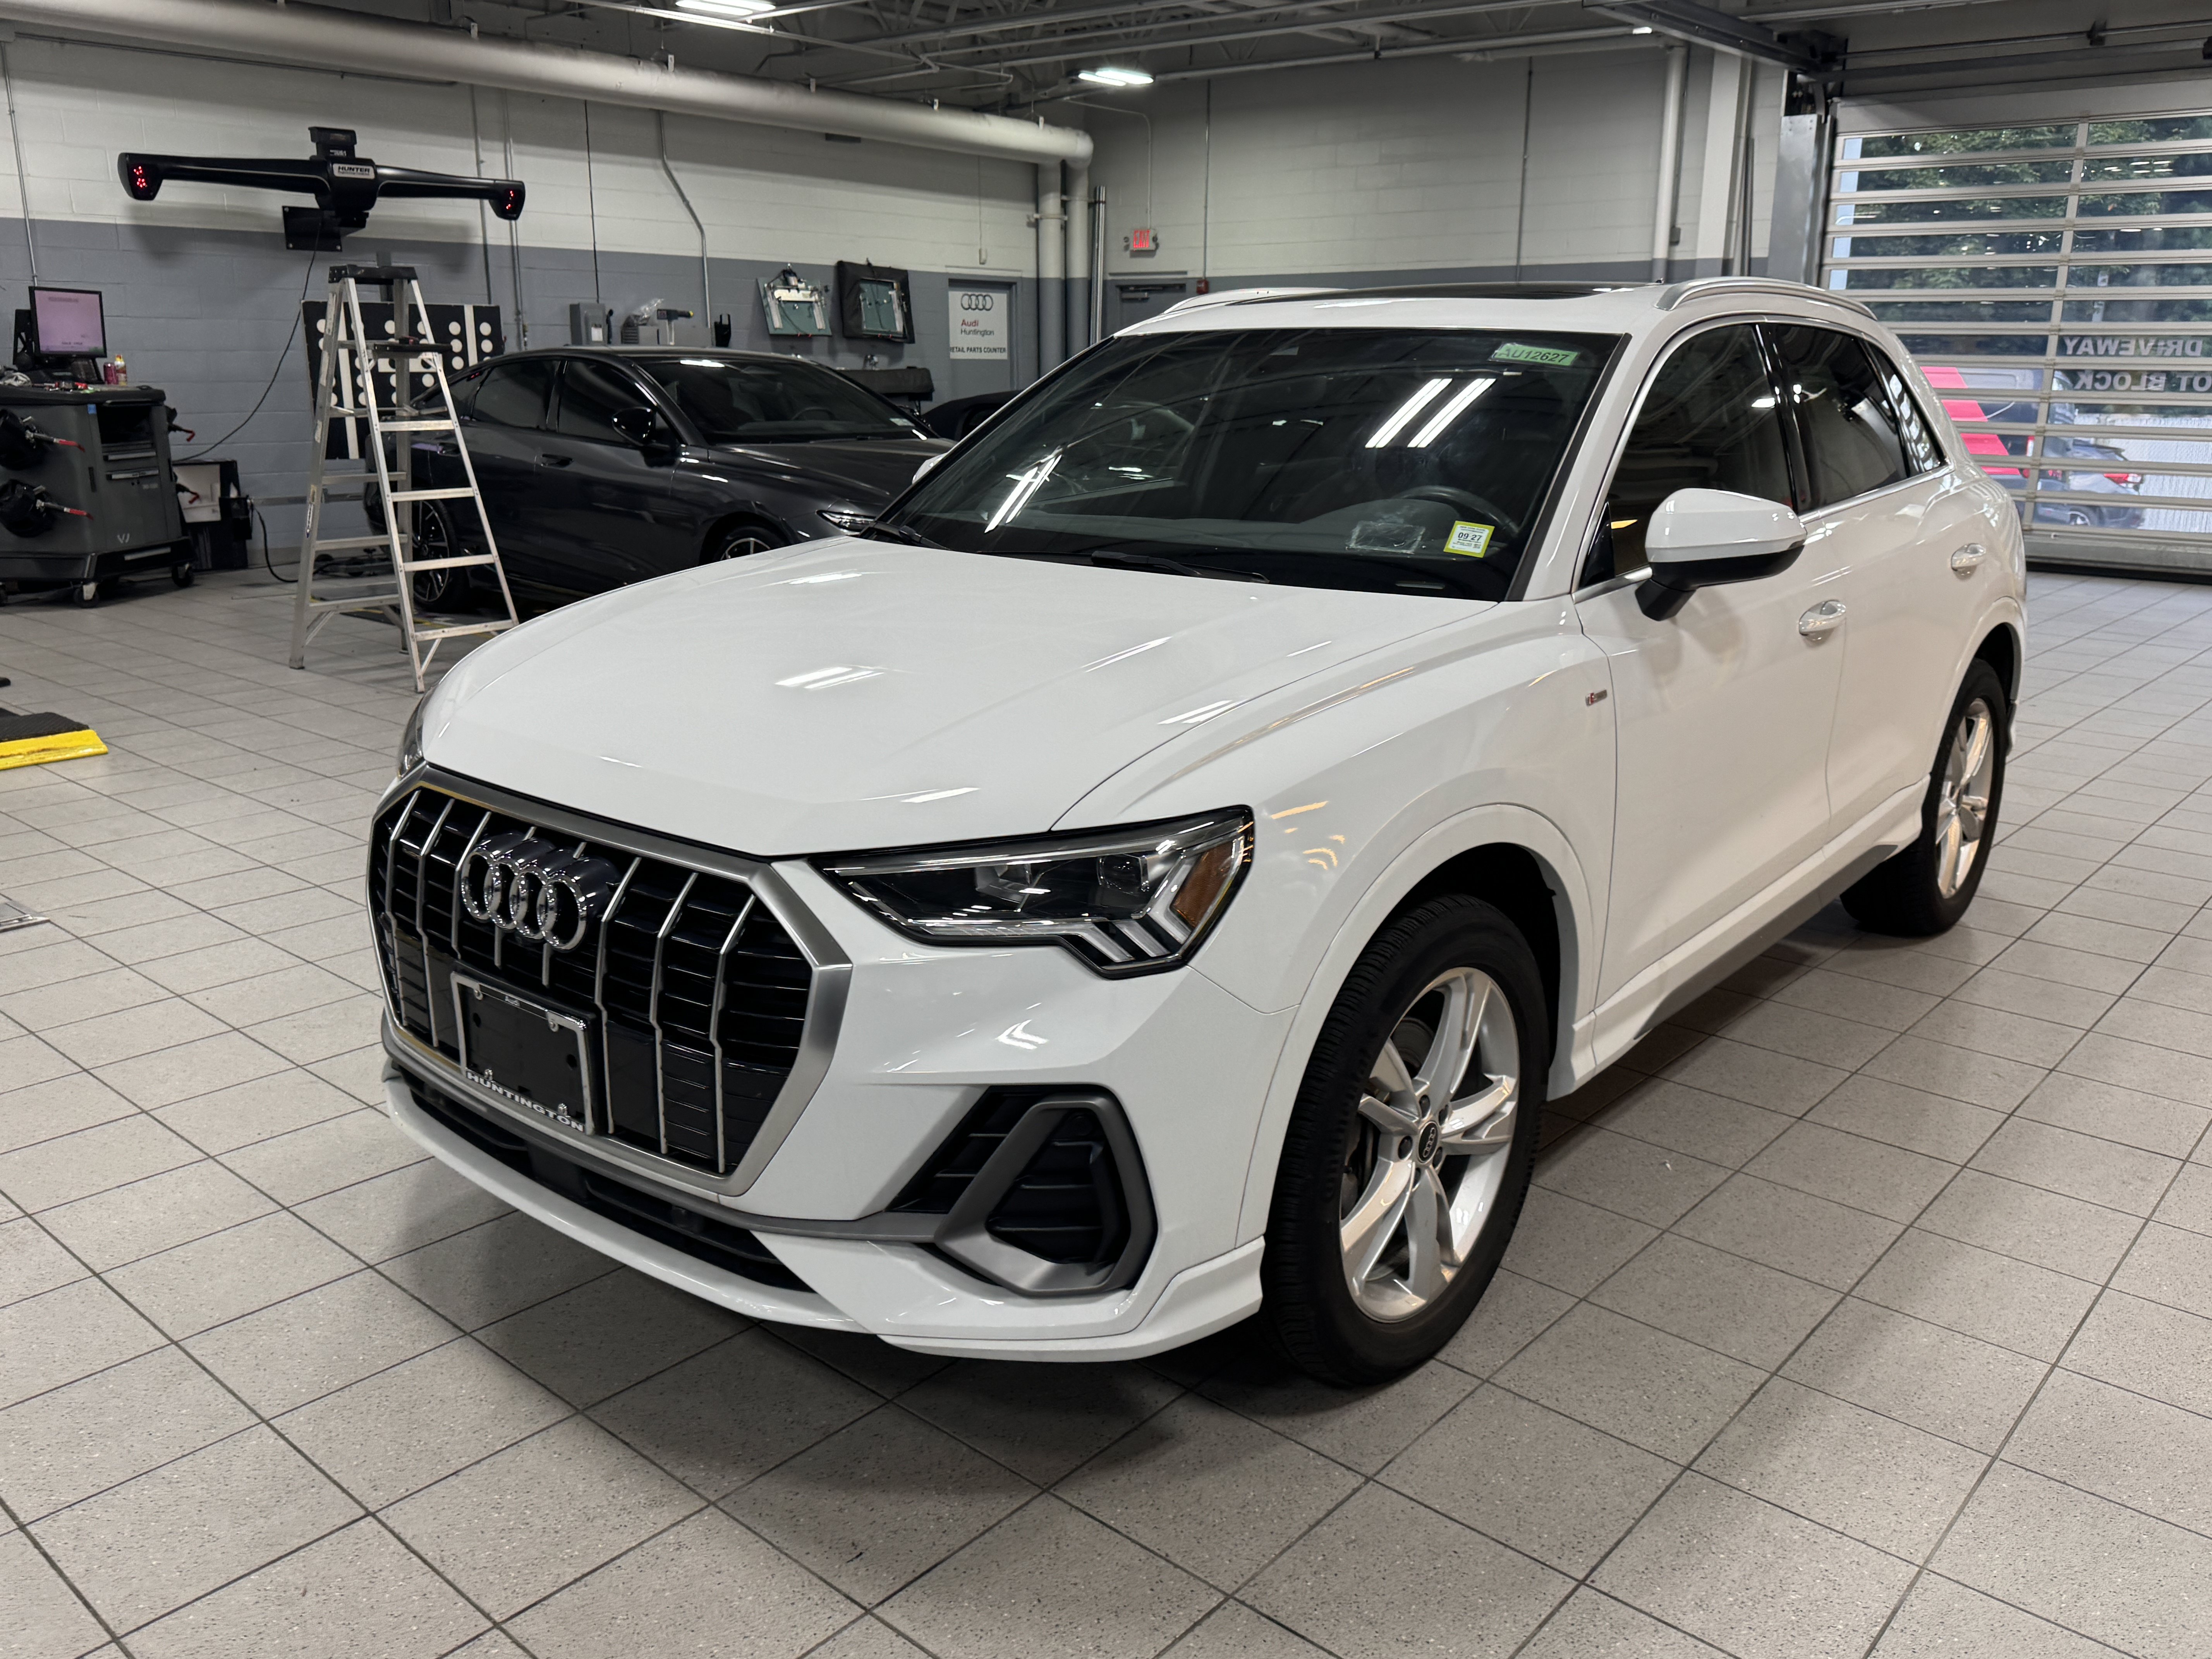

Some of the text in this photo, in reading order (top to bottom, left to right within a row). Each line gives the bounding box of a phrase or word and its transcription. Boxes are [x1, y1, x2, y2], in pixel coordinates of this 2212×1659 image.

[1133, 229, 1150, 248] EXIT
[1498, 349, 1570, 363] AU12627
[467, 1072, 584, 1132] HUNTINGTON
